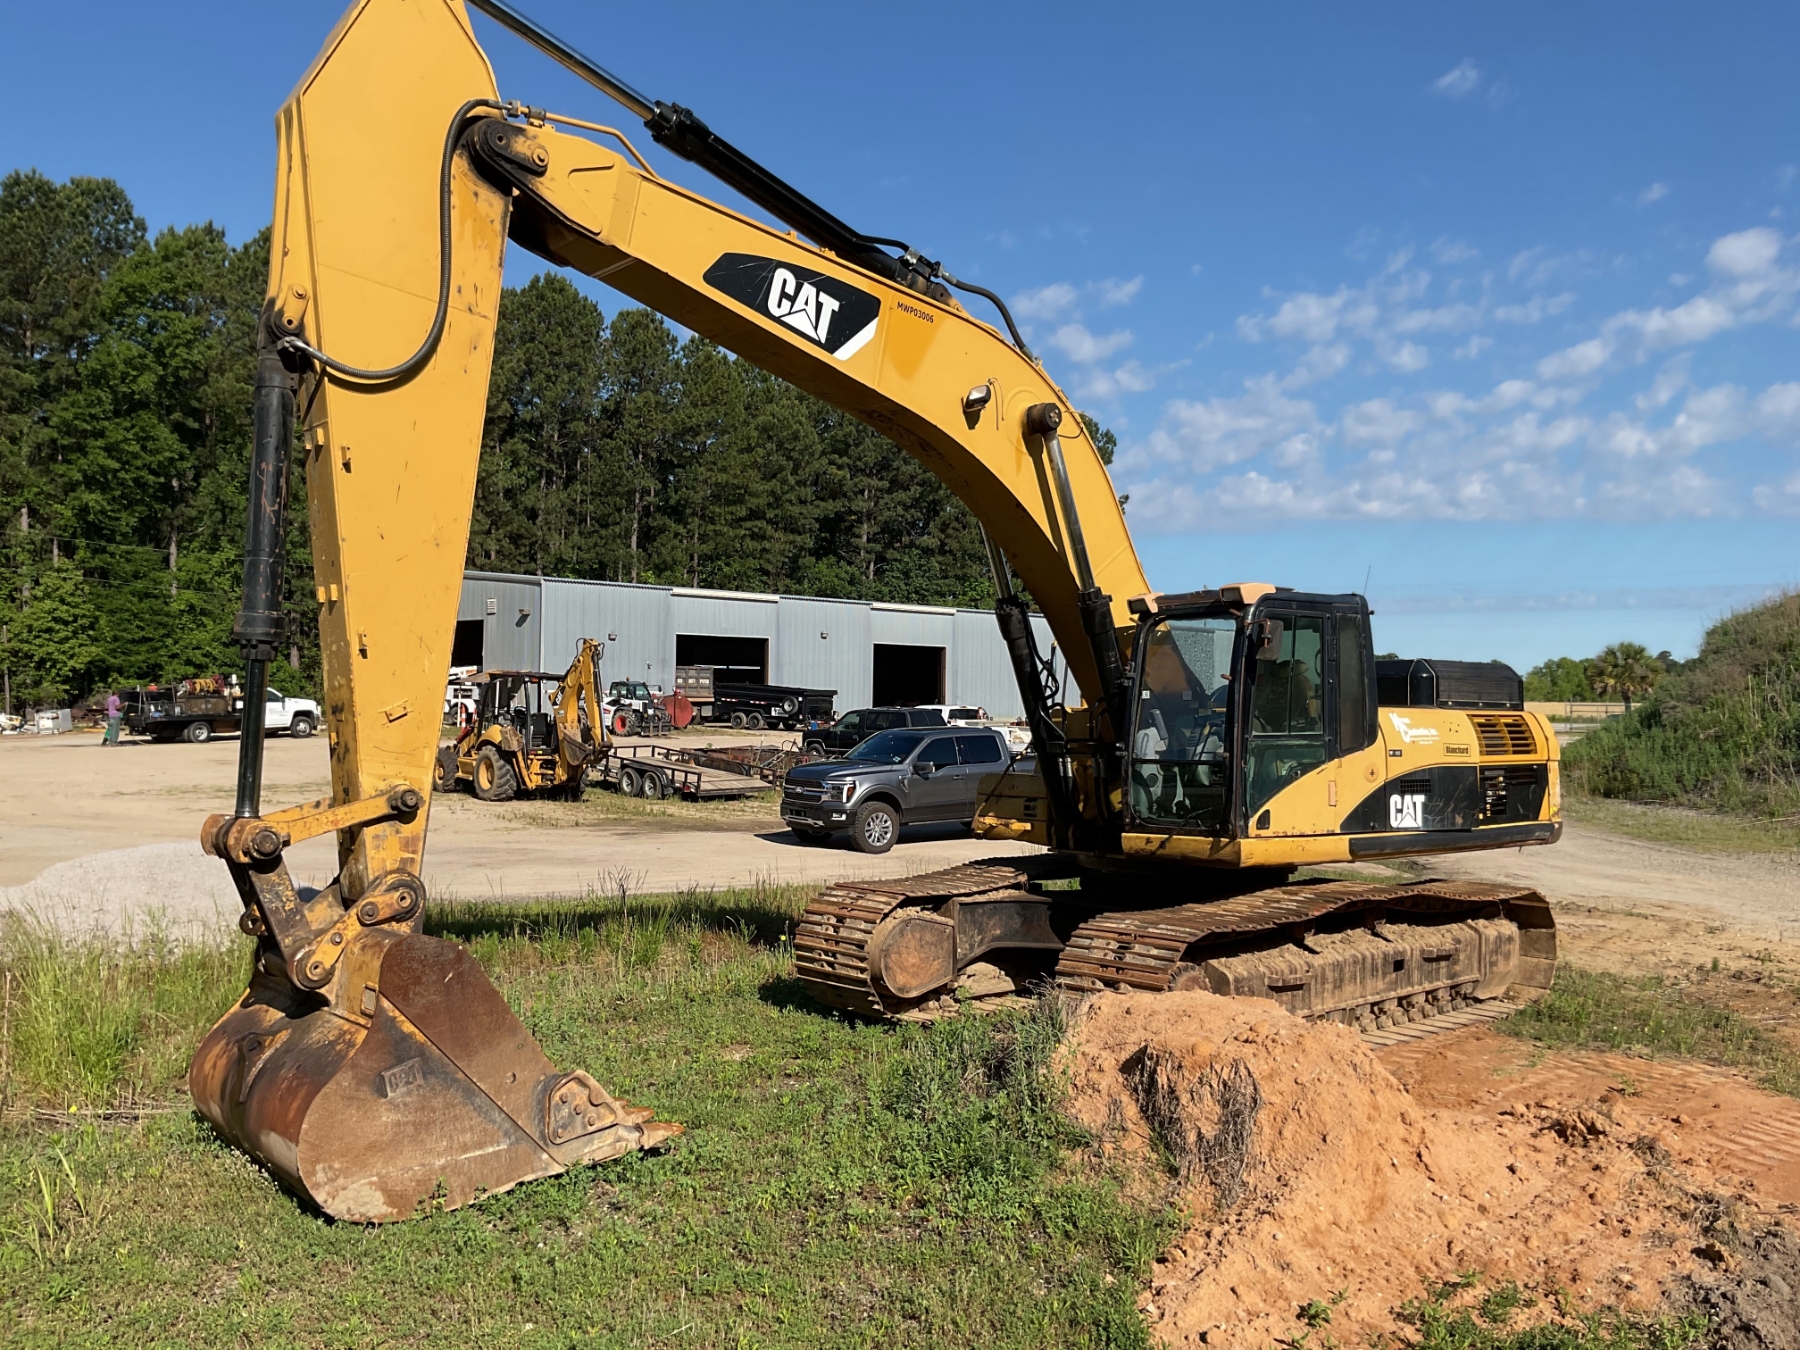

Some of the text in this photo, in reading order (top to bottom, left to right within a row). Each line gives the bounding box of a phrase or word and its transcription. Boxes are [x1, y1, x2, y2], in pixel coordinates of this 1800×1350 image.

[767, 267, 840, 344] CAT
[896, 301, 934, 324] MWP03006
[1445, 745, 1469, 755] Blanchard
[1389, 794, 1426, 828] CAT
